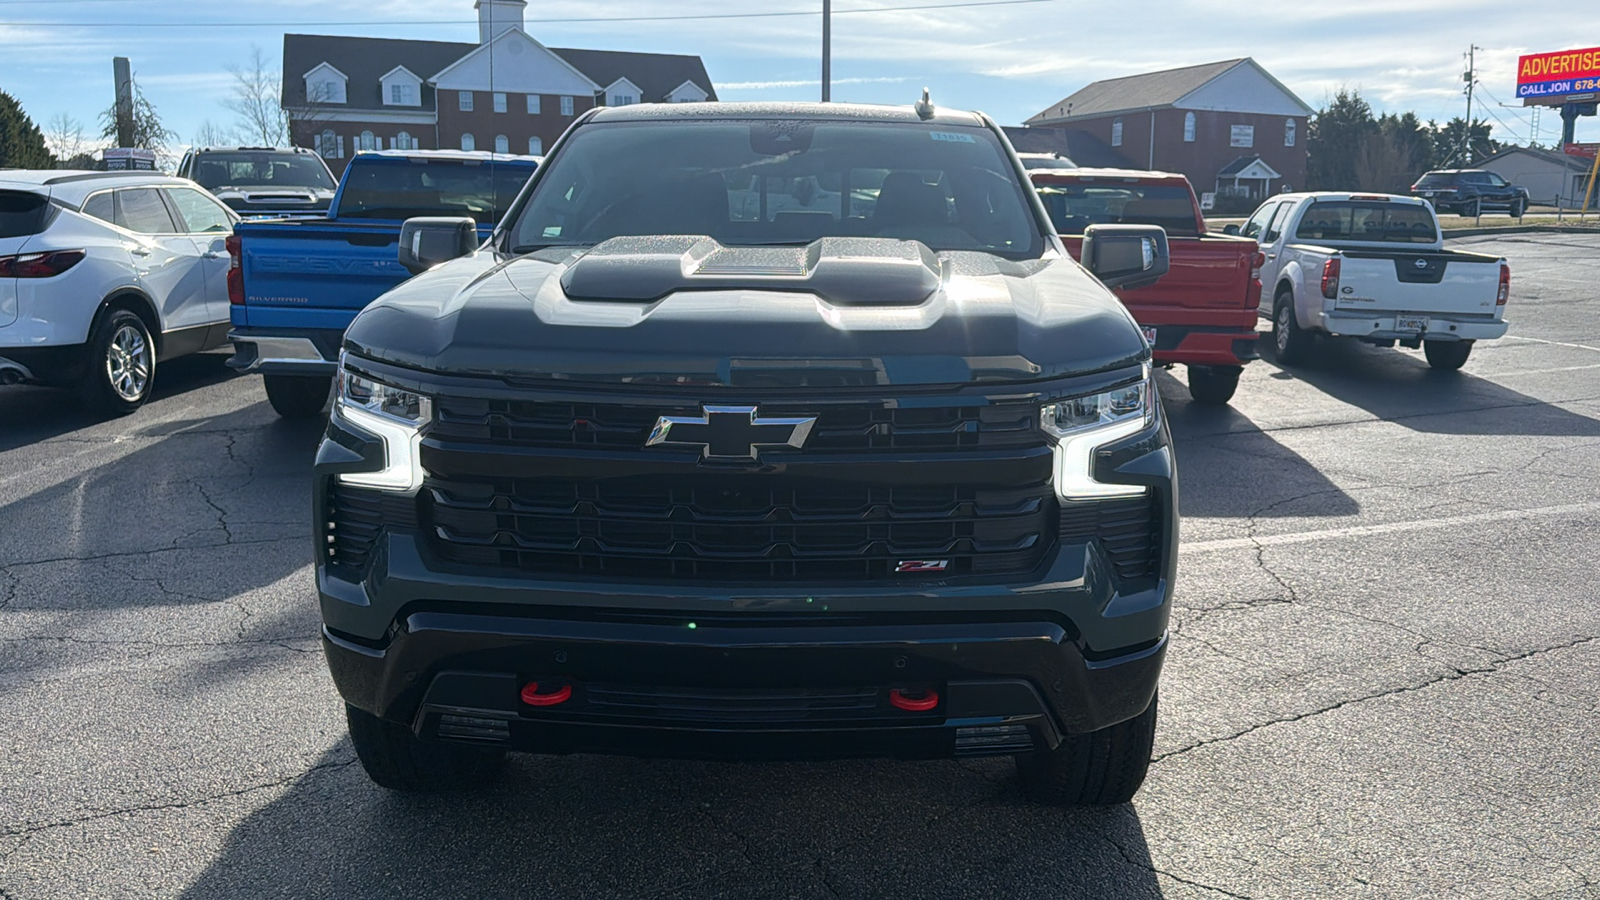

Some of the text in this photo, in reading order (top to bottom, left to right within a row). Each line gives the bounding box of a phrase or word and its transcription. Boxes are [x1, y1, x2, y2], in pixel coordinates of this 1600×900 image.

[1521, 51, 1600, 77] ADVERTISE
[1520, 84, 1546, 95] CALL
[1548, 82, 1570, 93] JON
